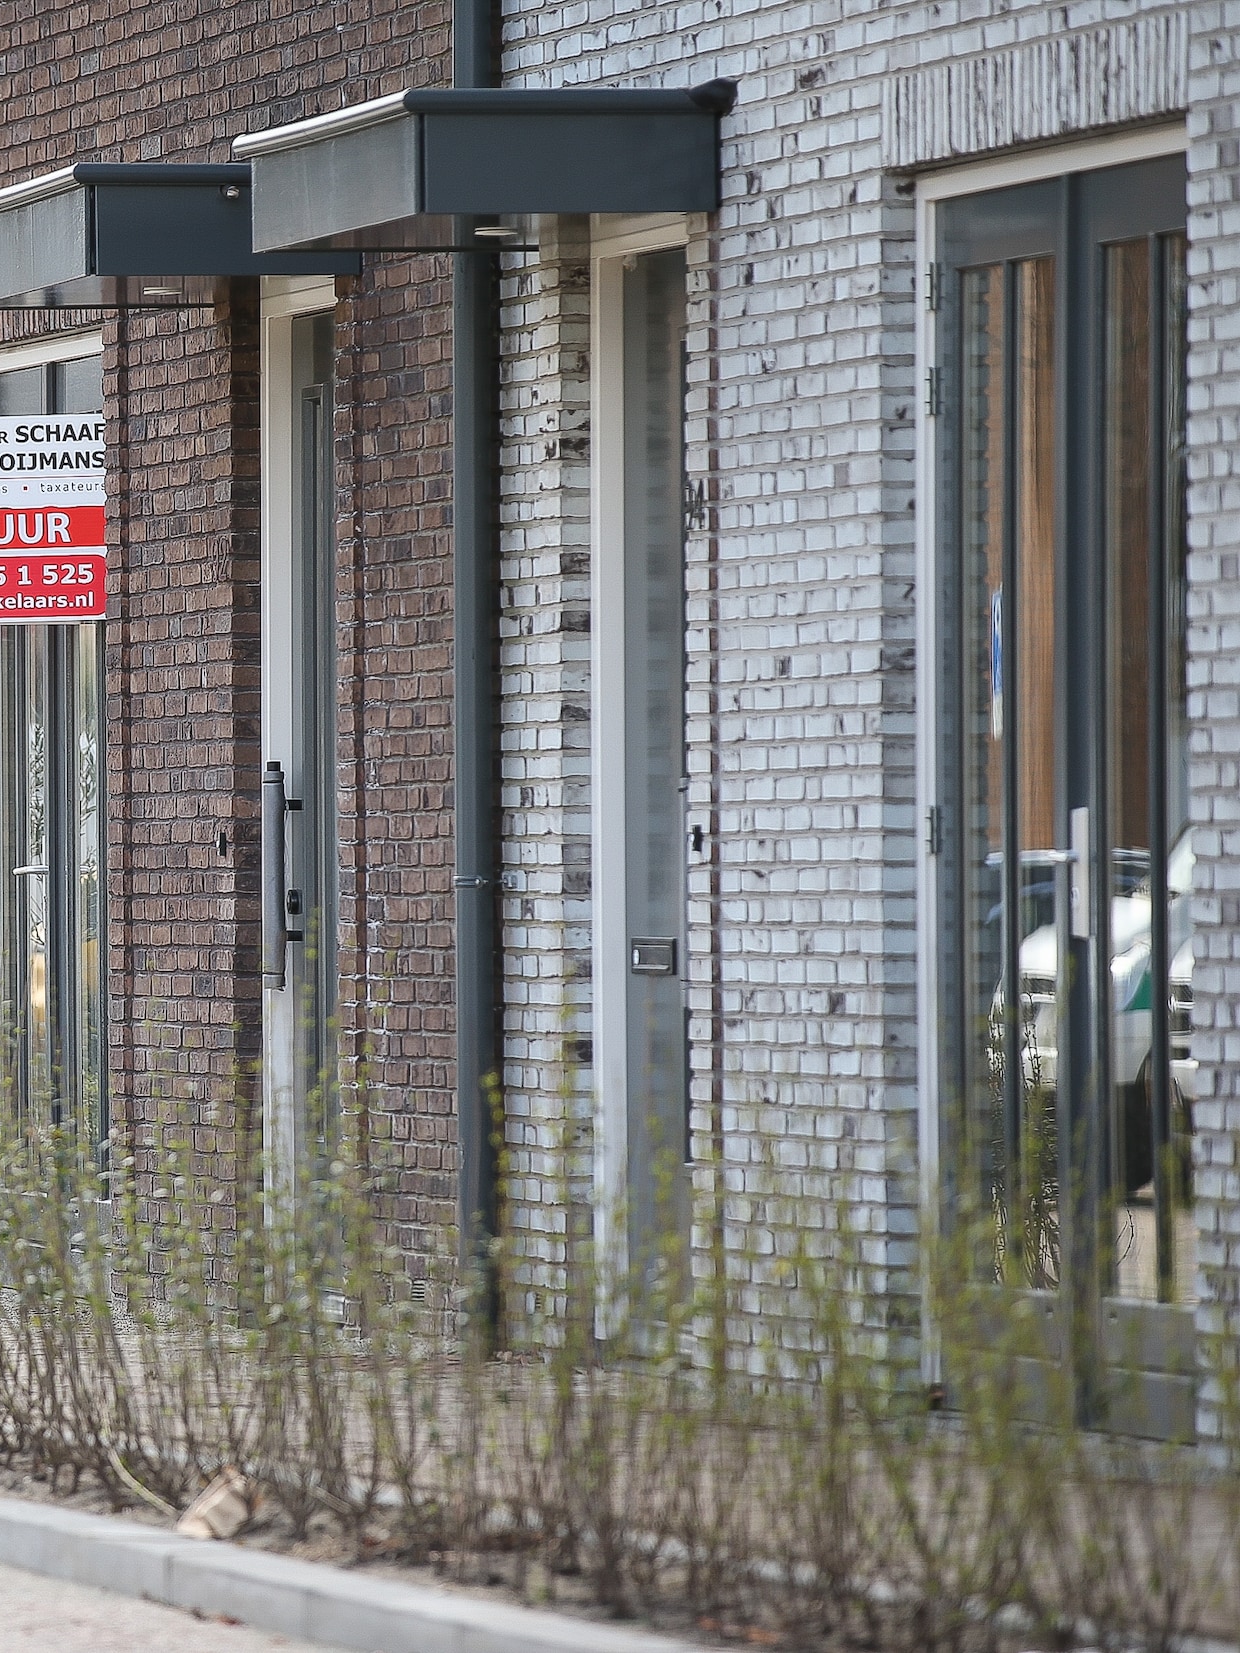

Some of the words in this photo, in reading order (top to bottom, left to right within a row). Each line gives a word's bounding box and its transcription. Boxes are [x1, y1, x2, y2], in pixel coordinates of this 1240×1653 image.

[15, 423, 106, 444] SCHAAF
[40, 481, 106, 493] taxateurs
[17, 565, 32, 587] 1
[42, 563, 95, 586] 525
